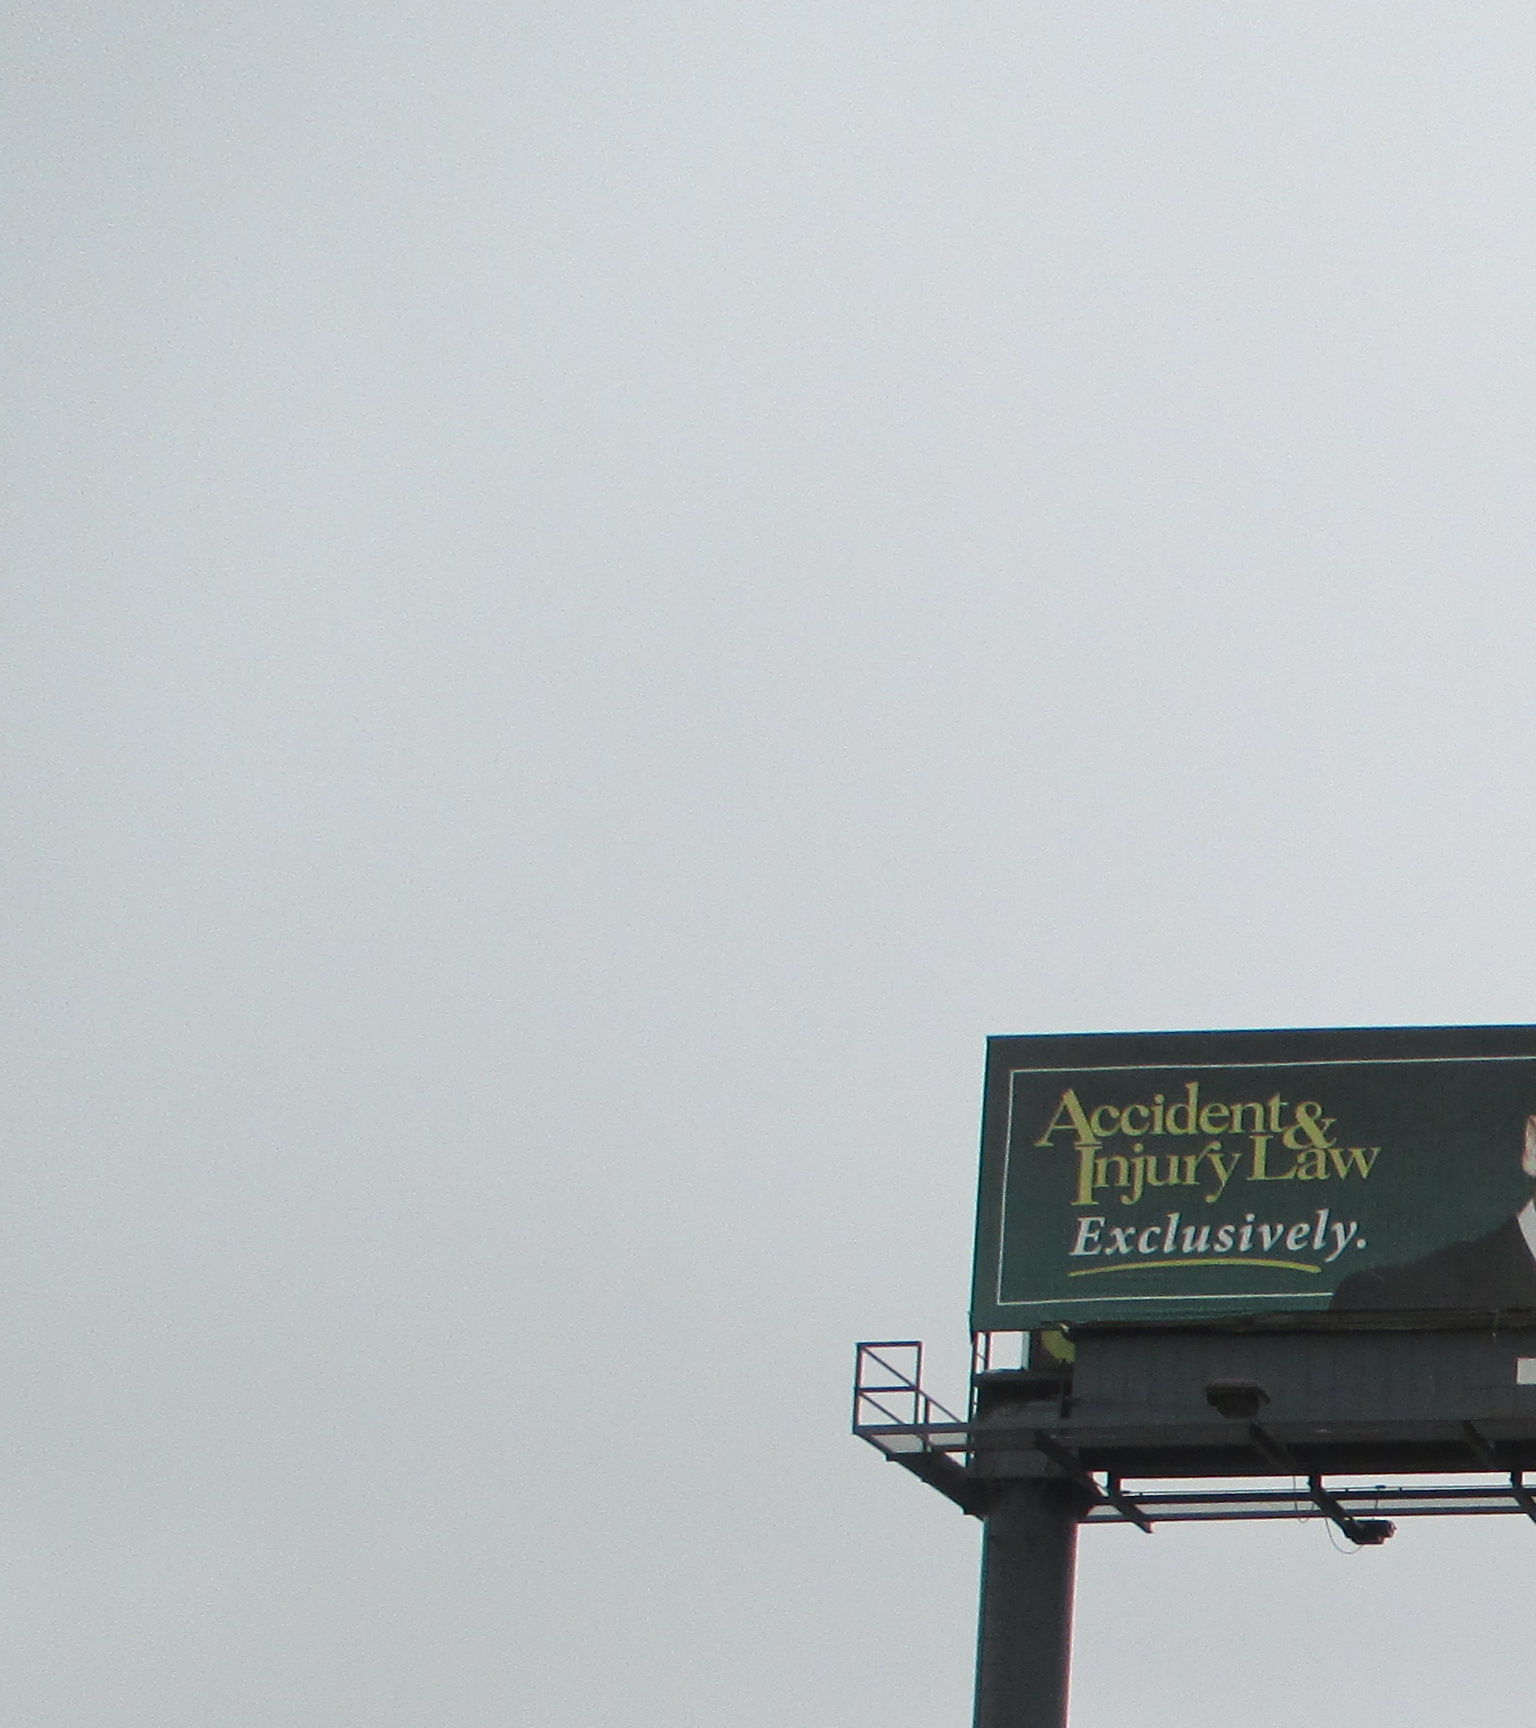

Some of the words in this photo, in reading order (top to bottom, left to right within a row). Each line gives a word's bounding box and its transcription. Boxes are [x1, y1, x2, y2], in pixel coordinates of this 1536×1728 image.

[1034, 1081, 1288, 1148] Accident
[1071, 1141, 1242, 1206] Injury
[1246, 1134, 1382, 1181] Law
[1068, 1208, 1367, 1263] Exclusively.
